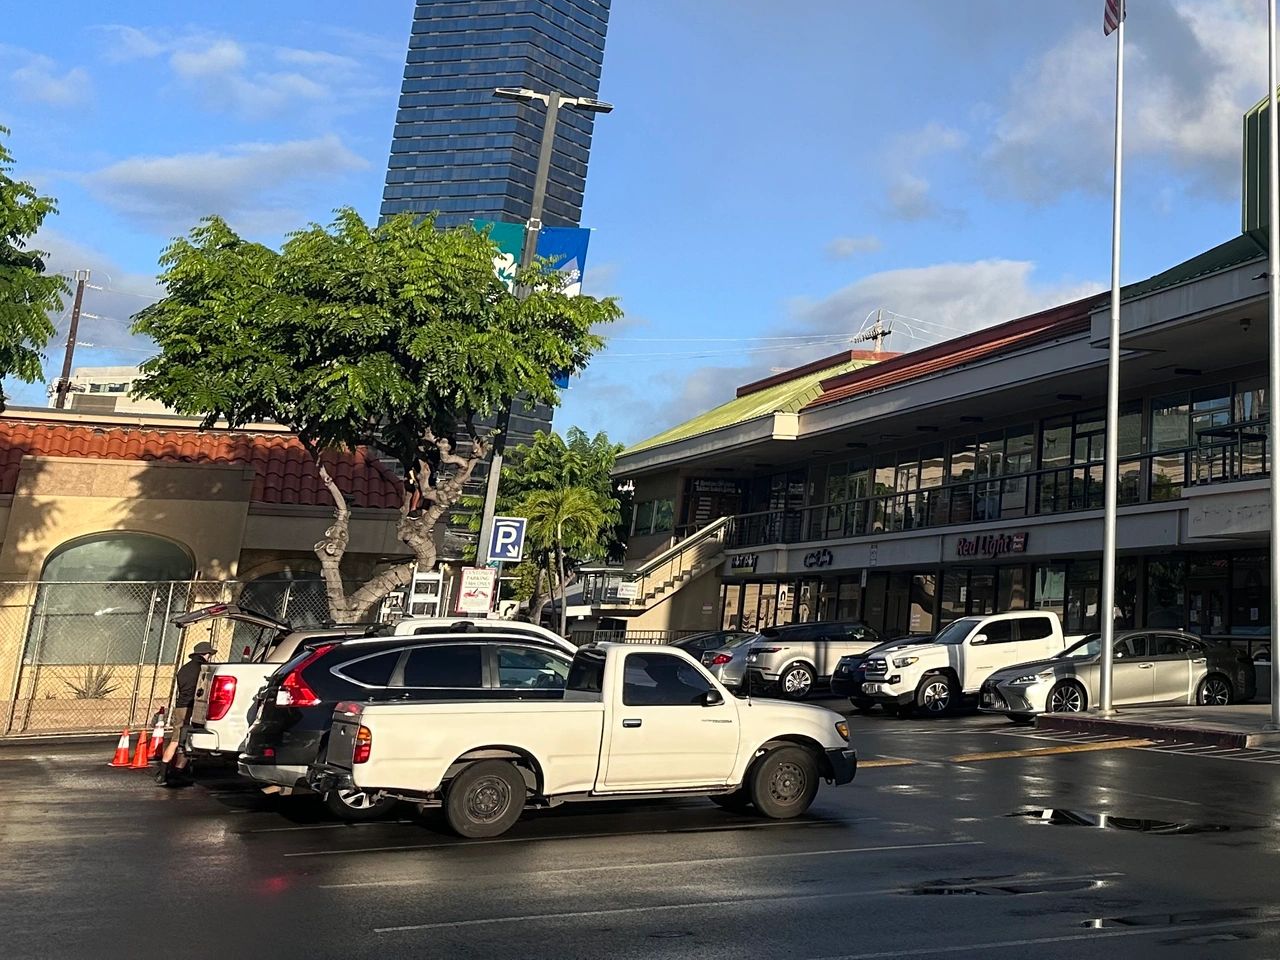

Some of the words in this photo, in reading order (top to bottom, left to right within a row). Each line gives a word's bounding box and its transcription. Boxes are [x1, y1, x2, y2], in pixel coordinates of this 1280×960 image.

[495, 526, 518, 553] P
[956, 536, 979, 556] Red
[981, 533, 1012, 559] Light
